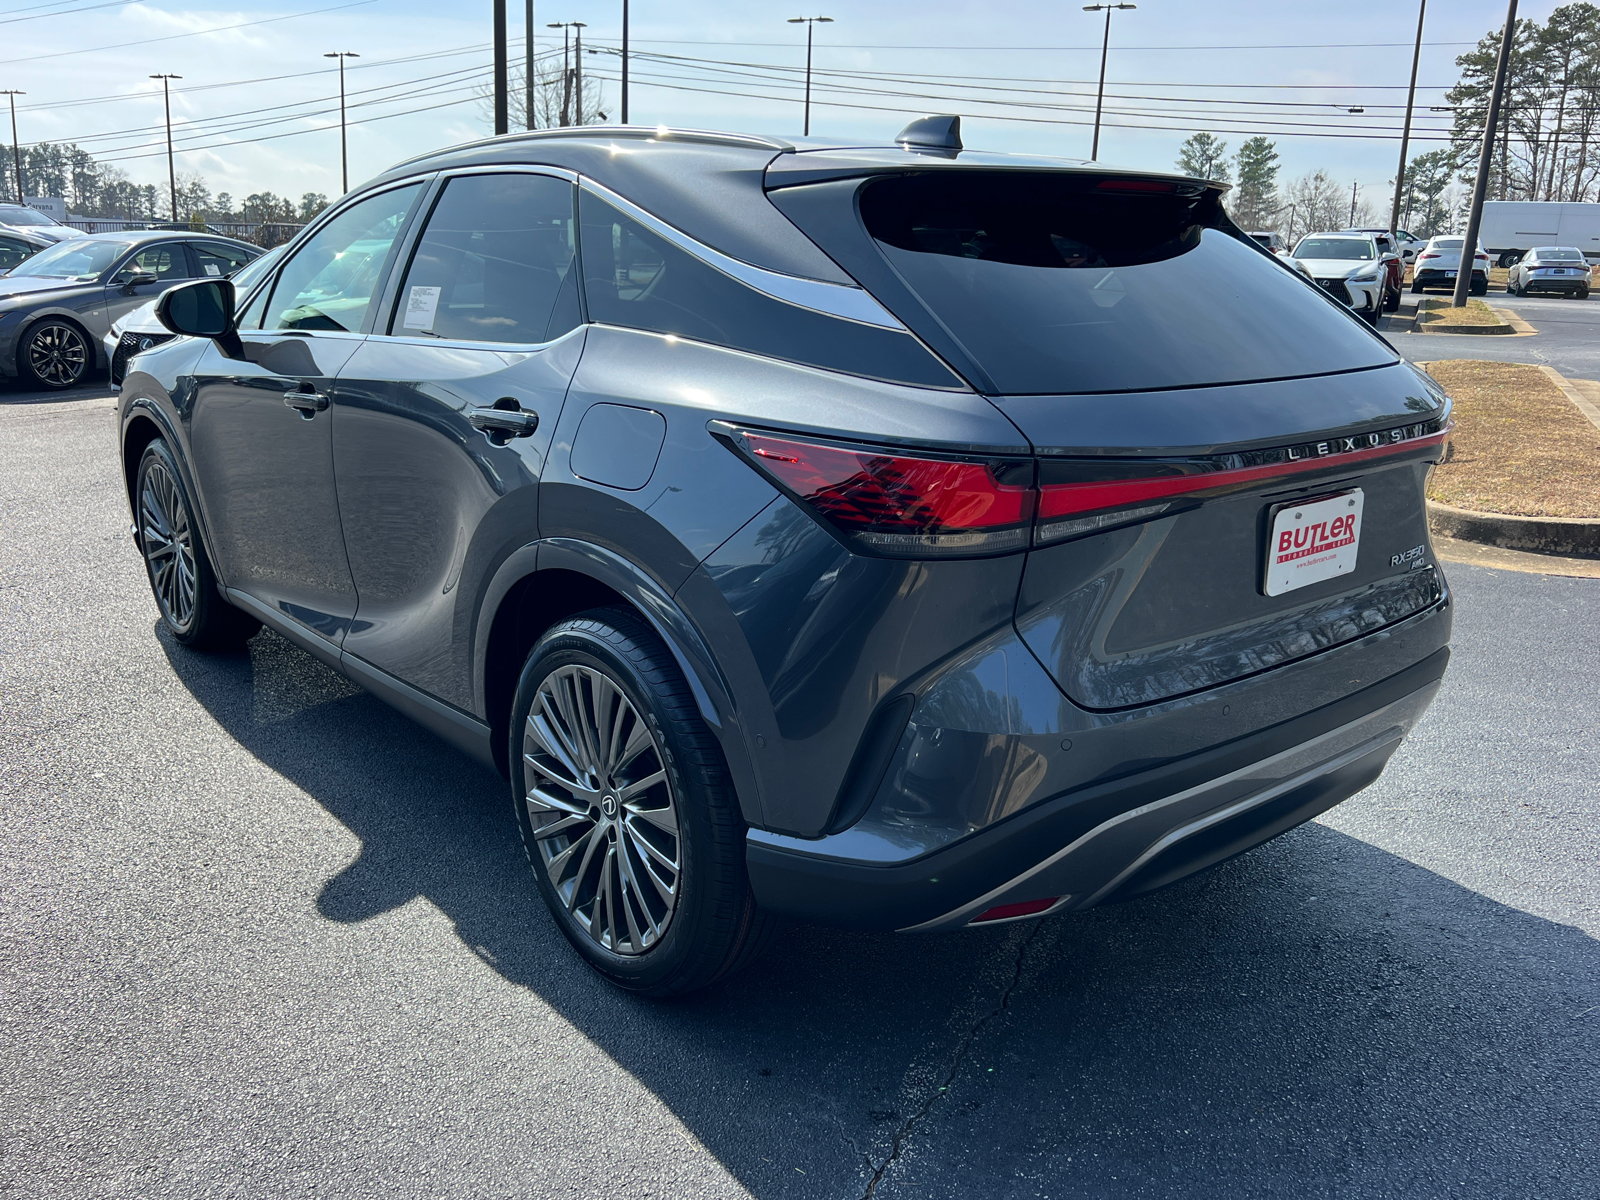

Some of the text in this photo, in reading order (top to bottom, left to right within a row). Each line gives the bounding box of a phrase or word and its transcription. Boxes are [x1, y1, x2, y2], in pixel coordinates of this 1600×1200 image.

[1288, 430, 1400, 460] LEXUS
[1332, 537, 1354, 548] GROUP
[1296, 554, 1337, 569] www.butlercars.com
[1391, 545, 1425, 567] RX350
[1411, 558, 1425, 569] AWD
